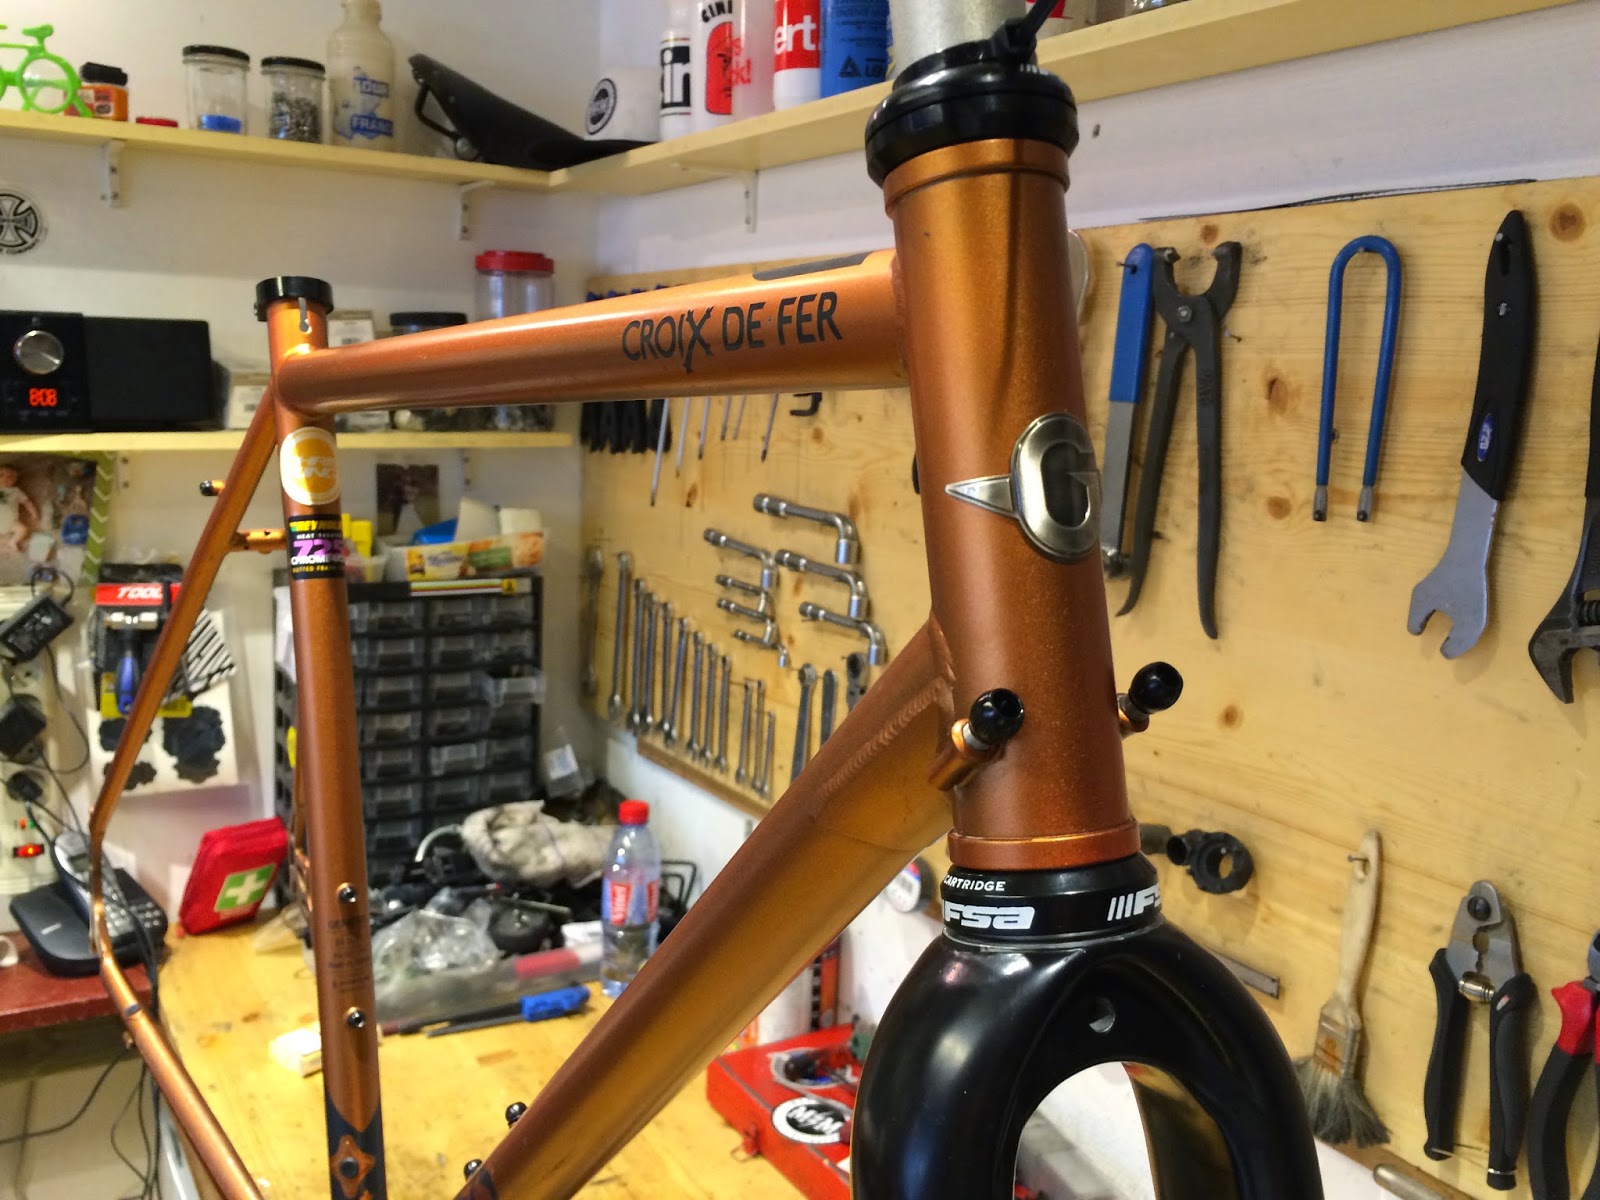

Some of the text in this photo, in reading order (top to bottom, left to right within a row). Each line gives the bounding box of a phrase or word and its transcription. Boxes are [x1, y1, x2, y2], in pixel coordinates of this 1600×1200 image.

[621, 291, 844, 375] CROIX DE FER
[943, 874, 1007, 892] CARTRIDGE
